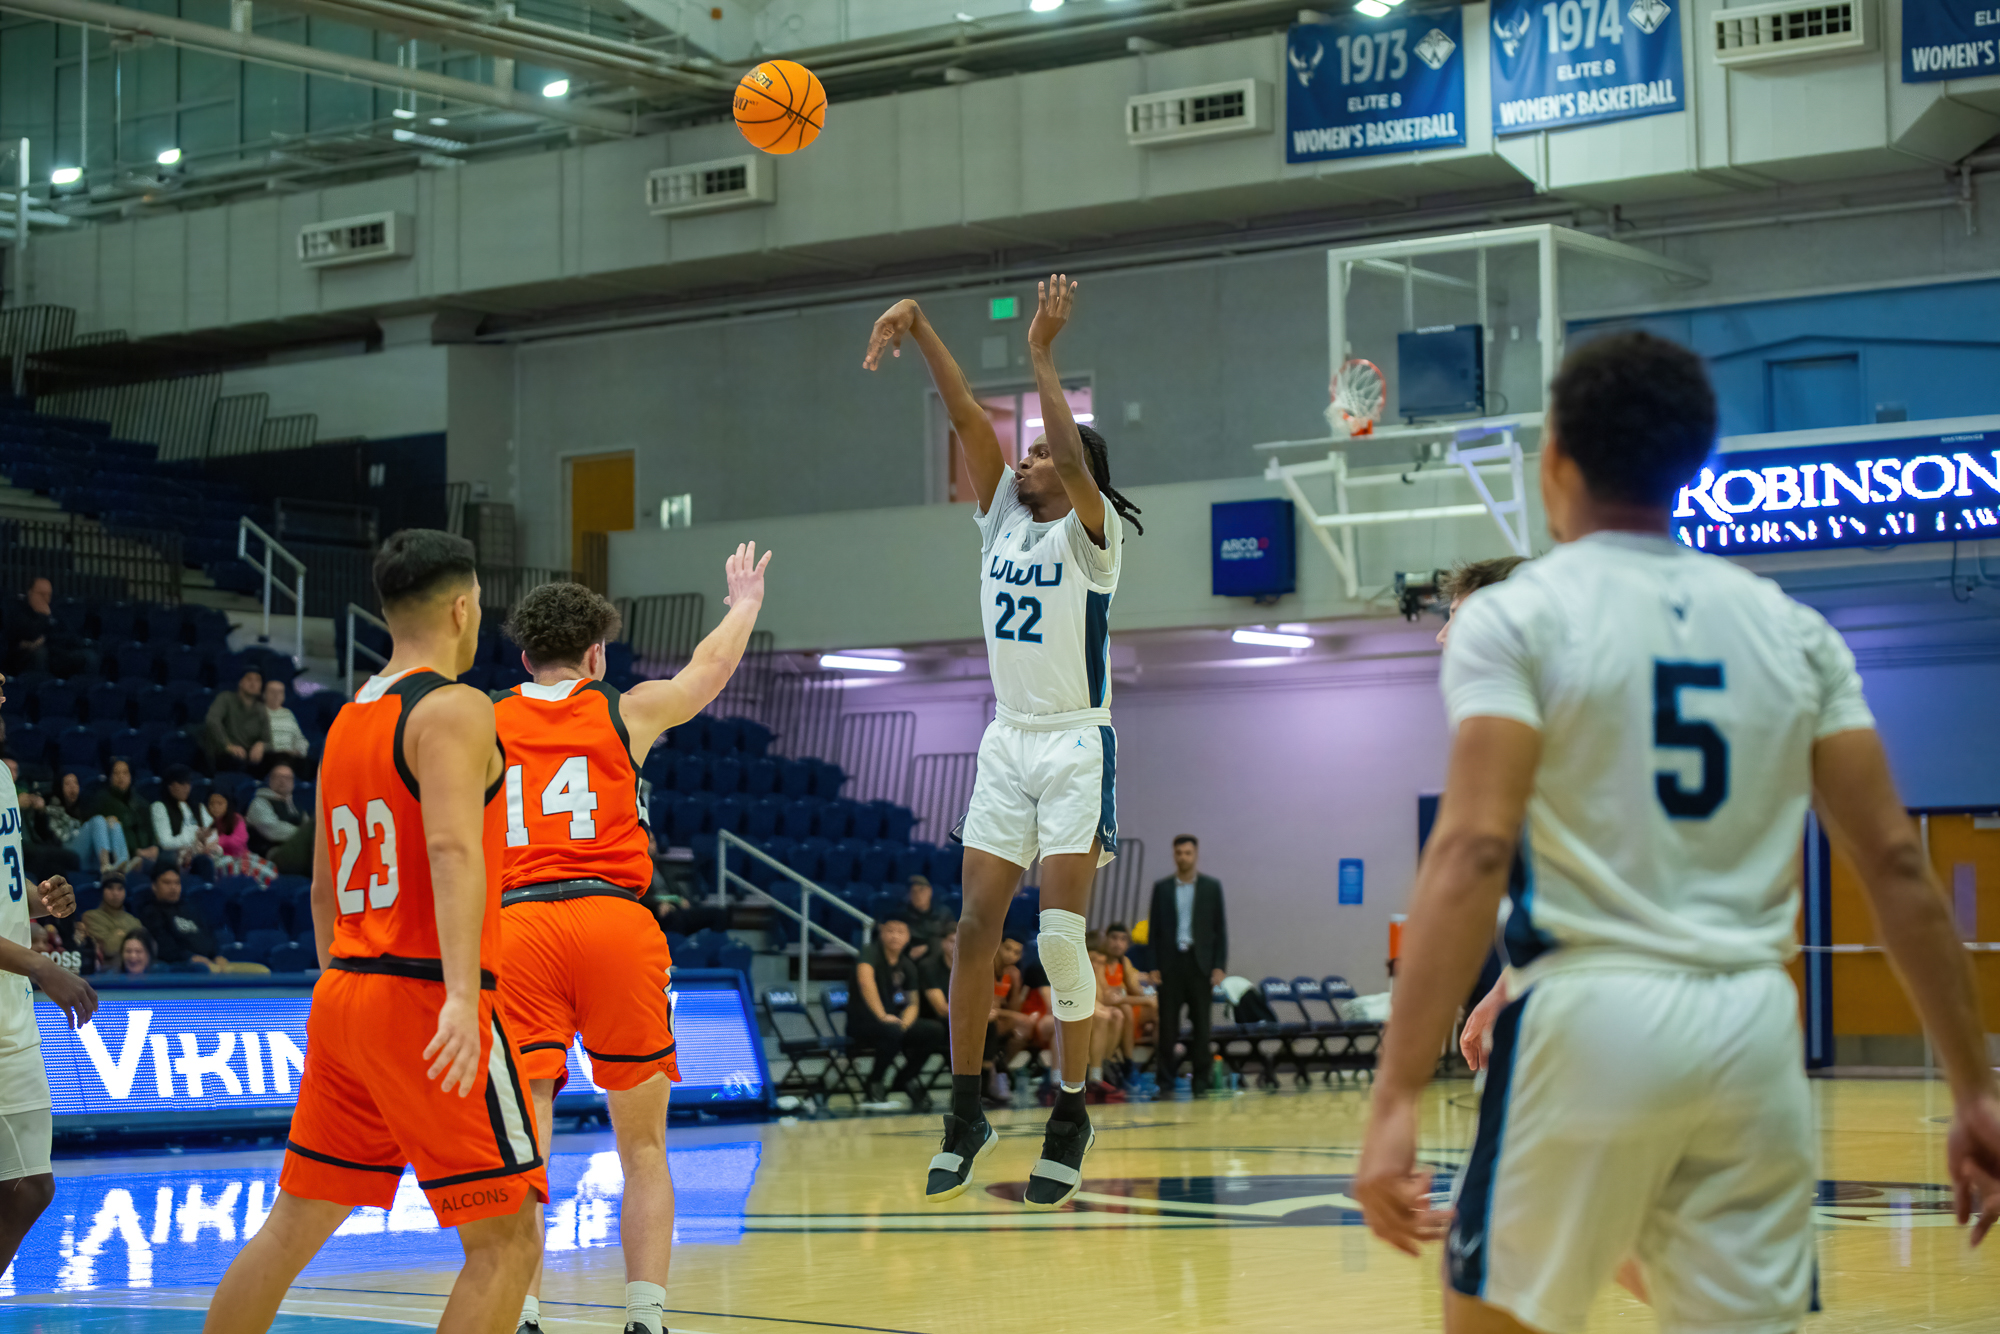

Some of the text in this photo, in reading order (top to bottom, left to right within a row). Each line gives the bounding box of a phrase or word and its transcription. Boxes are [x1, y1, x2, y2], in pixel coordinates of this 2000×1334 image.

[1542, 0, 1623, 54] 1974
[1336, 29, 1408, 85] 1973
[1557, 58, 1616, 82] ELITE 8
[1911, 40, 1995, 73] WOMEN'S
[1347, 94, 1389, 113] ELITE
[1500, 79, 1677, 126] WOMEN'S BASKETBALL
[1293, 112, 1458, 154] WOMEN'S BASKETBALL
[1673, 450, 2000, 523] ROBINSON
[995, 591, 1043, 644] 22
[1653, 658, 1731, 822] 5
[505, 755, 598, 848] 14
[3, 845, 23, 903] 3
[331, 797, 400, 916] 23
[41, 951, 82, 969] OSS
[434, 1188, 509, 1214] ALCONS
